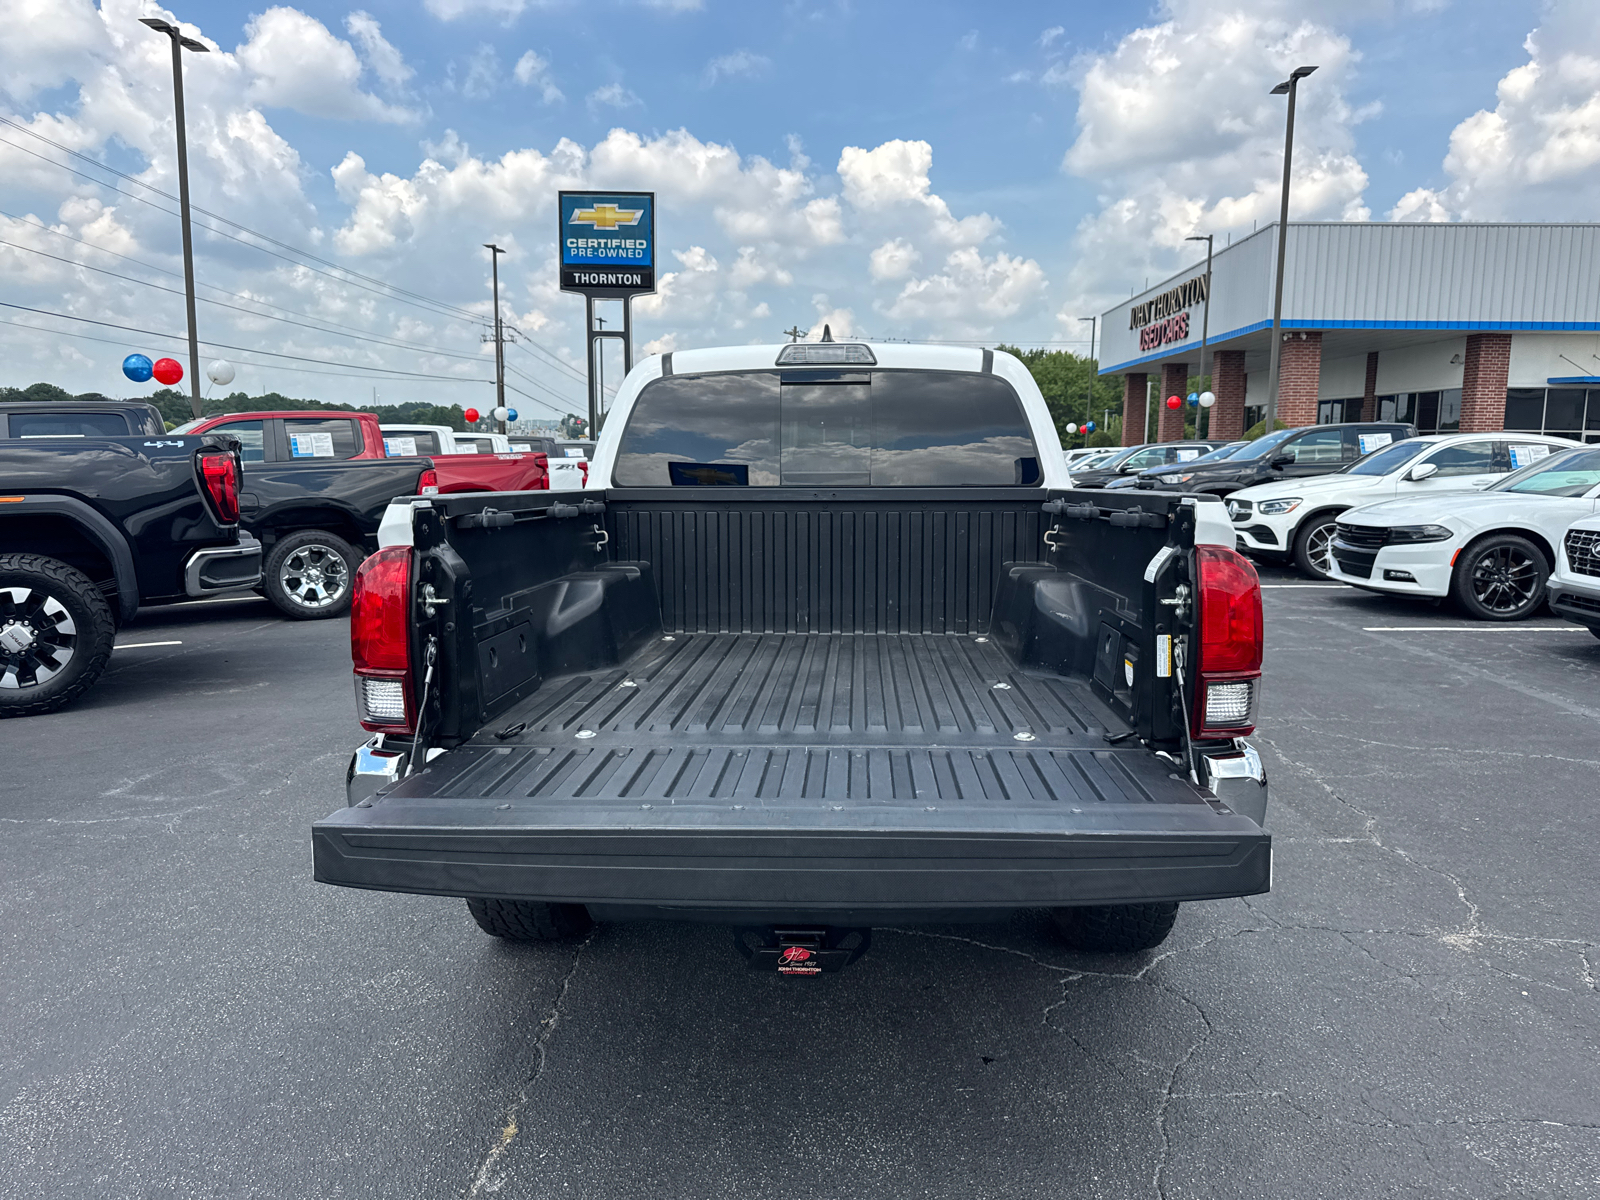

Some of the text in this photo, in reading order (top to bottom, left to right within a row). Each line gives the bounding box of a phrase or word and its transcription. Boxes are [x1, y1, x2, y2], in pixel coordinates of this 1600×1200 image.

[566, 238, 647, 249] CERTIFIED
[570, 248, 643, 258] PRE-OWNED
[573, 273, 641, 285] THORNTON
[1129, 300, 1154, 330] JOHN
[1139, 312, 1190, 351] USED CARS
[6, 630, 24, 648] GMC
